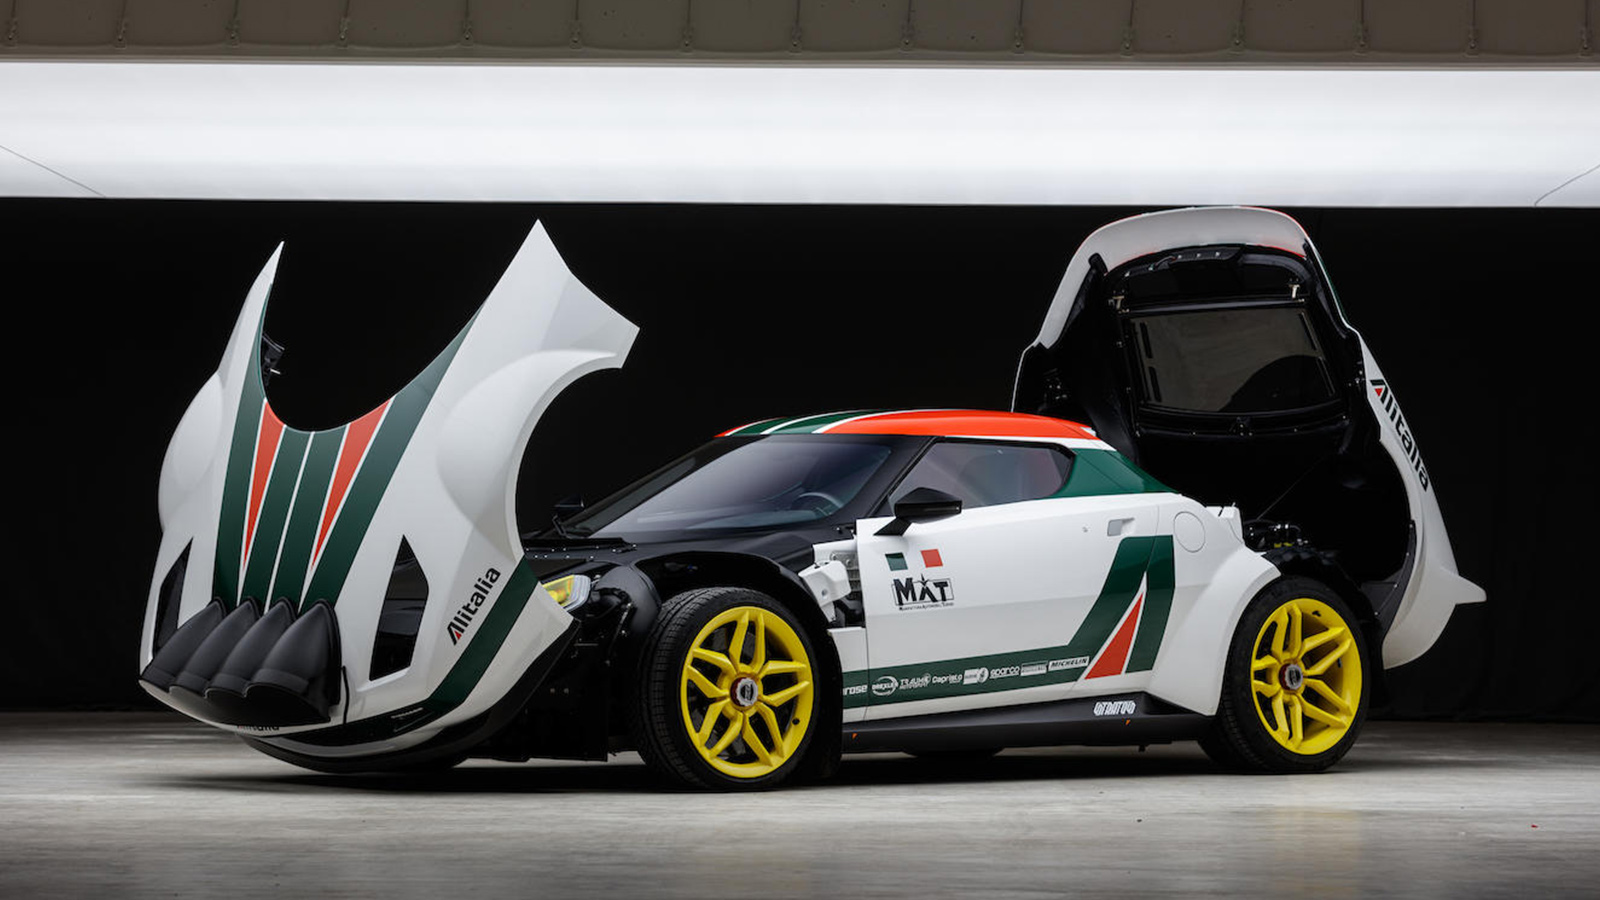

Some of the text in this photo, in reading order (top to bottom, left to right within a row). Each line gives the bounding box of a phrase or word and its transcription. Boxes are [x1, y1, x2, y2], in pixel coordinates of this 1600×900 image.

[1370, 379, 1428, 492] Alitalia
[447, 568, 501, 646] Alitalia
[893, 574, 949, 606] MAT
[1051, 658, 1087, 668] MICHELIN
